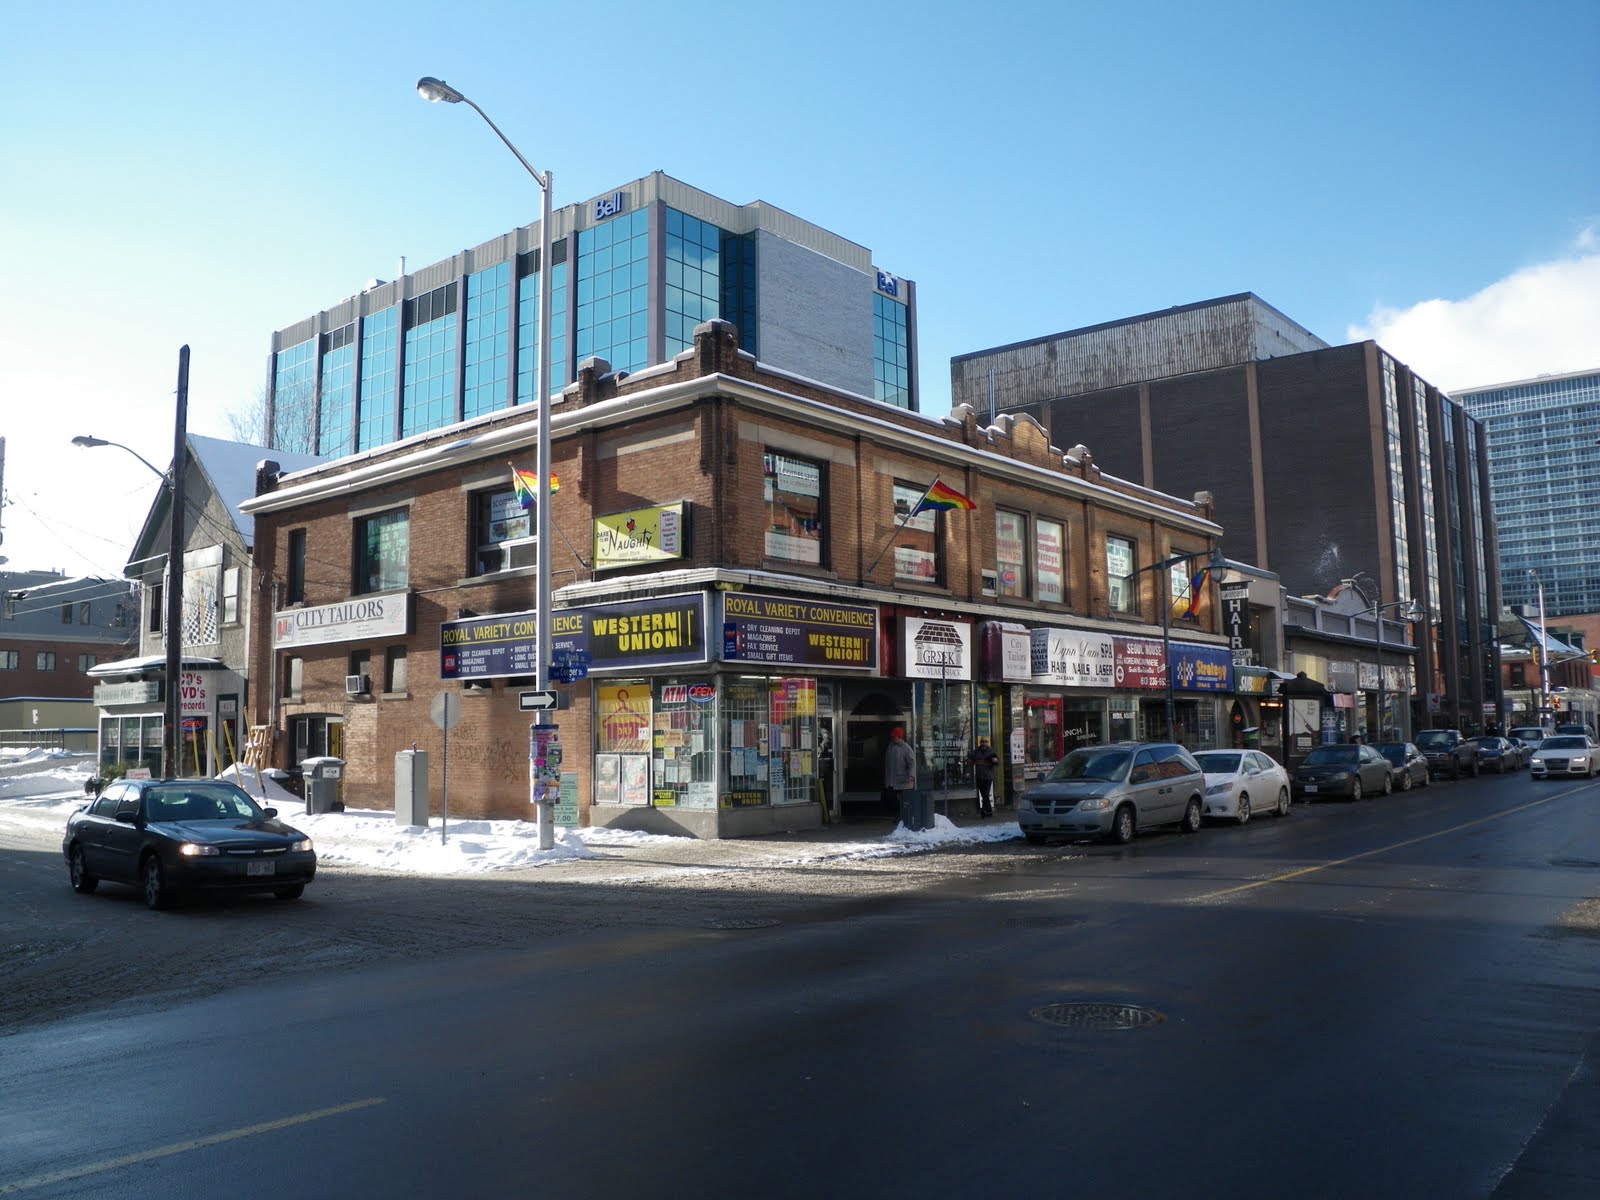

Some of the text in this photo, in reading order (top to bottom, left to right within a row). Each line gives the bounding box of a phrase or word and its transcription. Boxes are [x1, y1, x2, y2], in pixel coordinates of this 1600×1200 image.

[594, 192, 622, 220] Bell
[297, 600, 384, 627] CITY TAILORS
[726, 598, 874, 625] ROYAL VARIETY CONVENIENCE
[593, 612, 677, 635] WESTERN
[760, 626, 783, 635] CLEANING
[1229, 600, 1243, 648] HAIR
[443, 630, 470, 643] ROYAL
[473, 624, 511, 639] VARIETY
[747, 634, 776, 642] MAGAZINES
[618, 631, 678, 651] UNION
[809, 634, 861, 648] WESTERN
[1010, 638, 1022, 651] City
[826, 648, 861, 661] UNION
[1053, 637, 1077, 660] Lynn
[1101, 642, 1113, 659] SPA
[1127, 643, 1162, 656] SEOUL HOUSE
[747, 652, 764, 660] SMALL
[1008, 650, 1026, 662] Tailors
[1051, 661, 1113, 676] HAIR NAILS LASER
[1196, 660, 1227, 681] Strategy
[182, 687, 206, 699] VD's
[663, 687, 687, 702] ATM
[690, 686, 715, 697] OPEN
[617, 727, 632, 737] DRY
